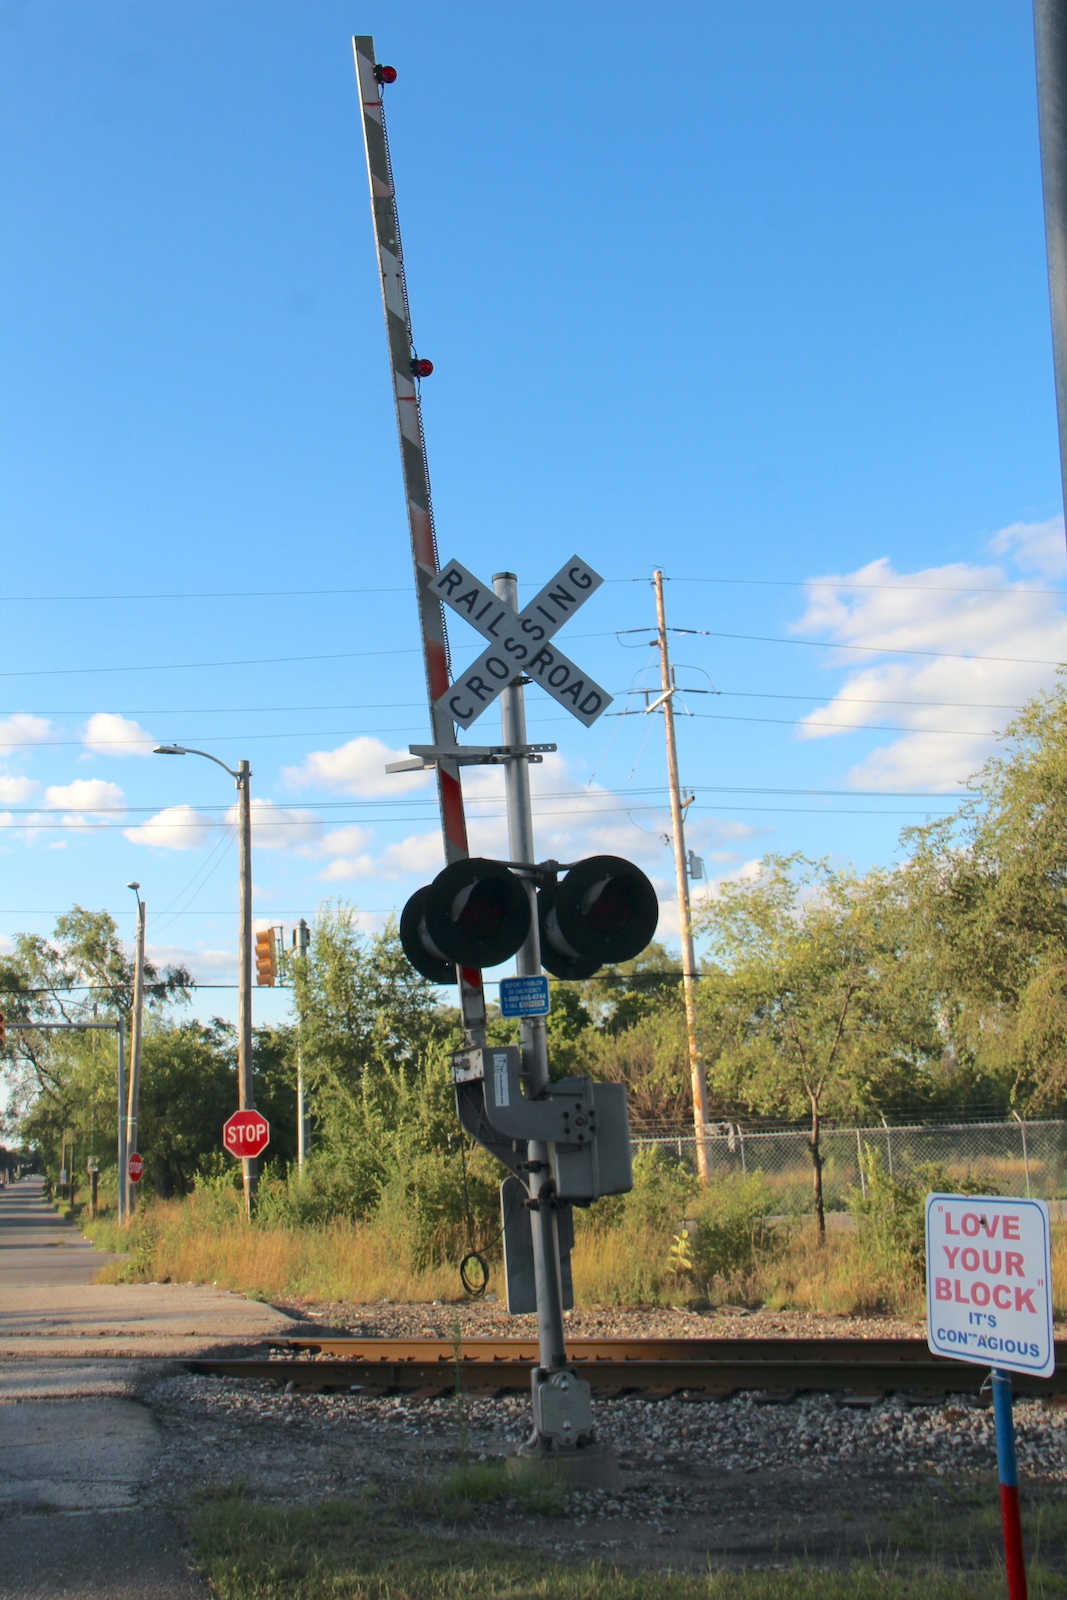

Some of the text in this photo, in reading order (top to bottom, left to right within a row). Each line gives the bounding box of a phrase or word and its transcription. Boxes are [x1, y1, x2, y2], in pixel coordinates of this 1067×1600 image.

[438, 569, 602, 715] RAIL ROAD
[449, 567, 592, 719] CROSSING
[227, 1124, 266, 1144] STOP
[129, 1162, 143, 1174] STOP
[941, 1245, 1026, 1277] YOUR
[969, 1311, 997, 1328] IT'S
